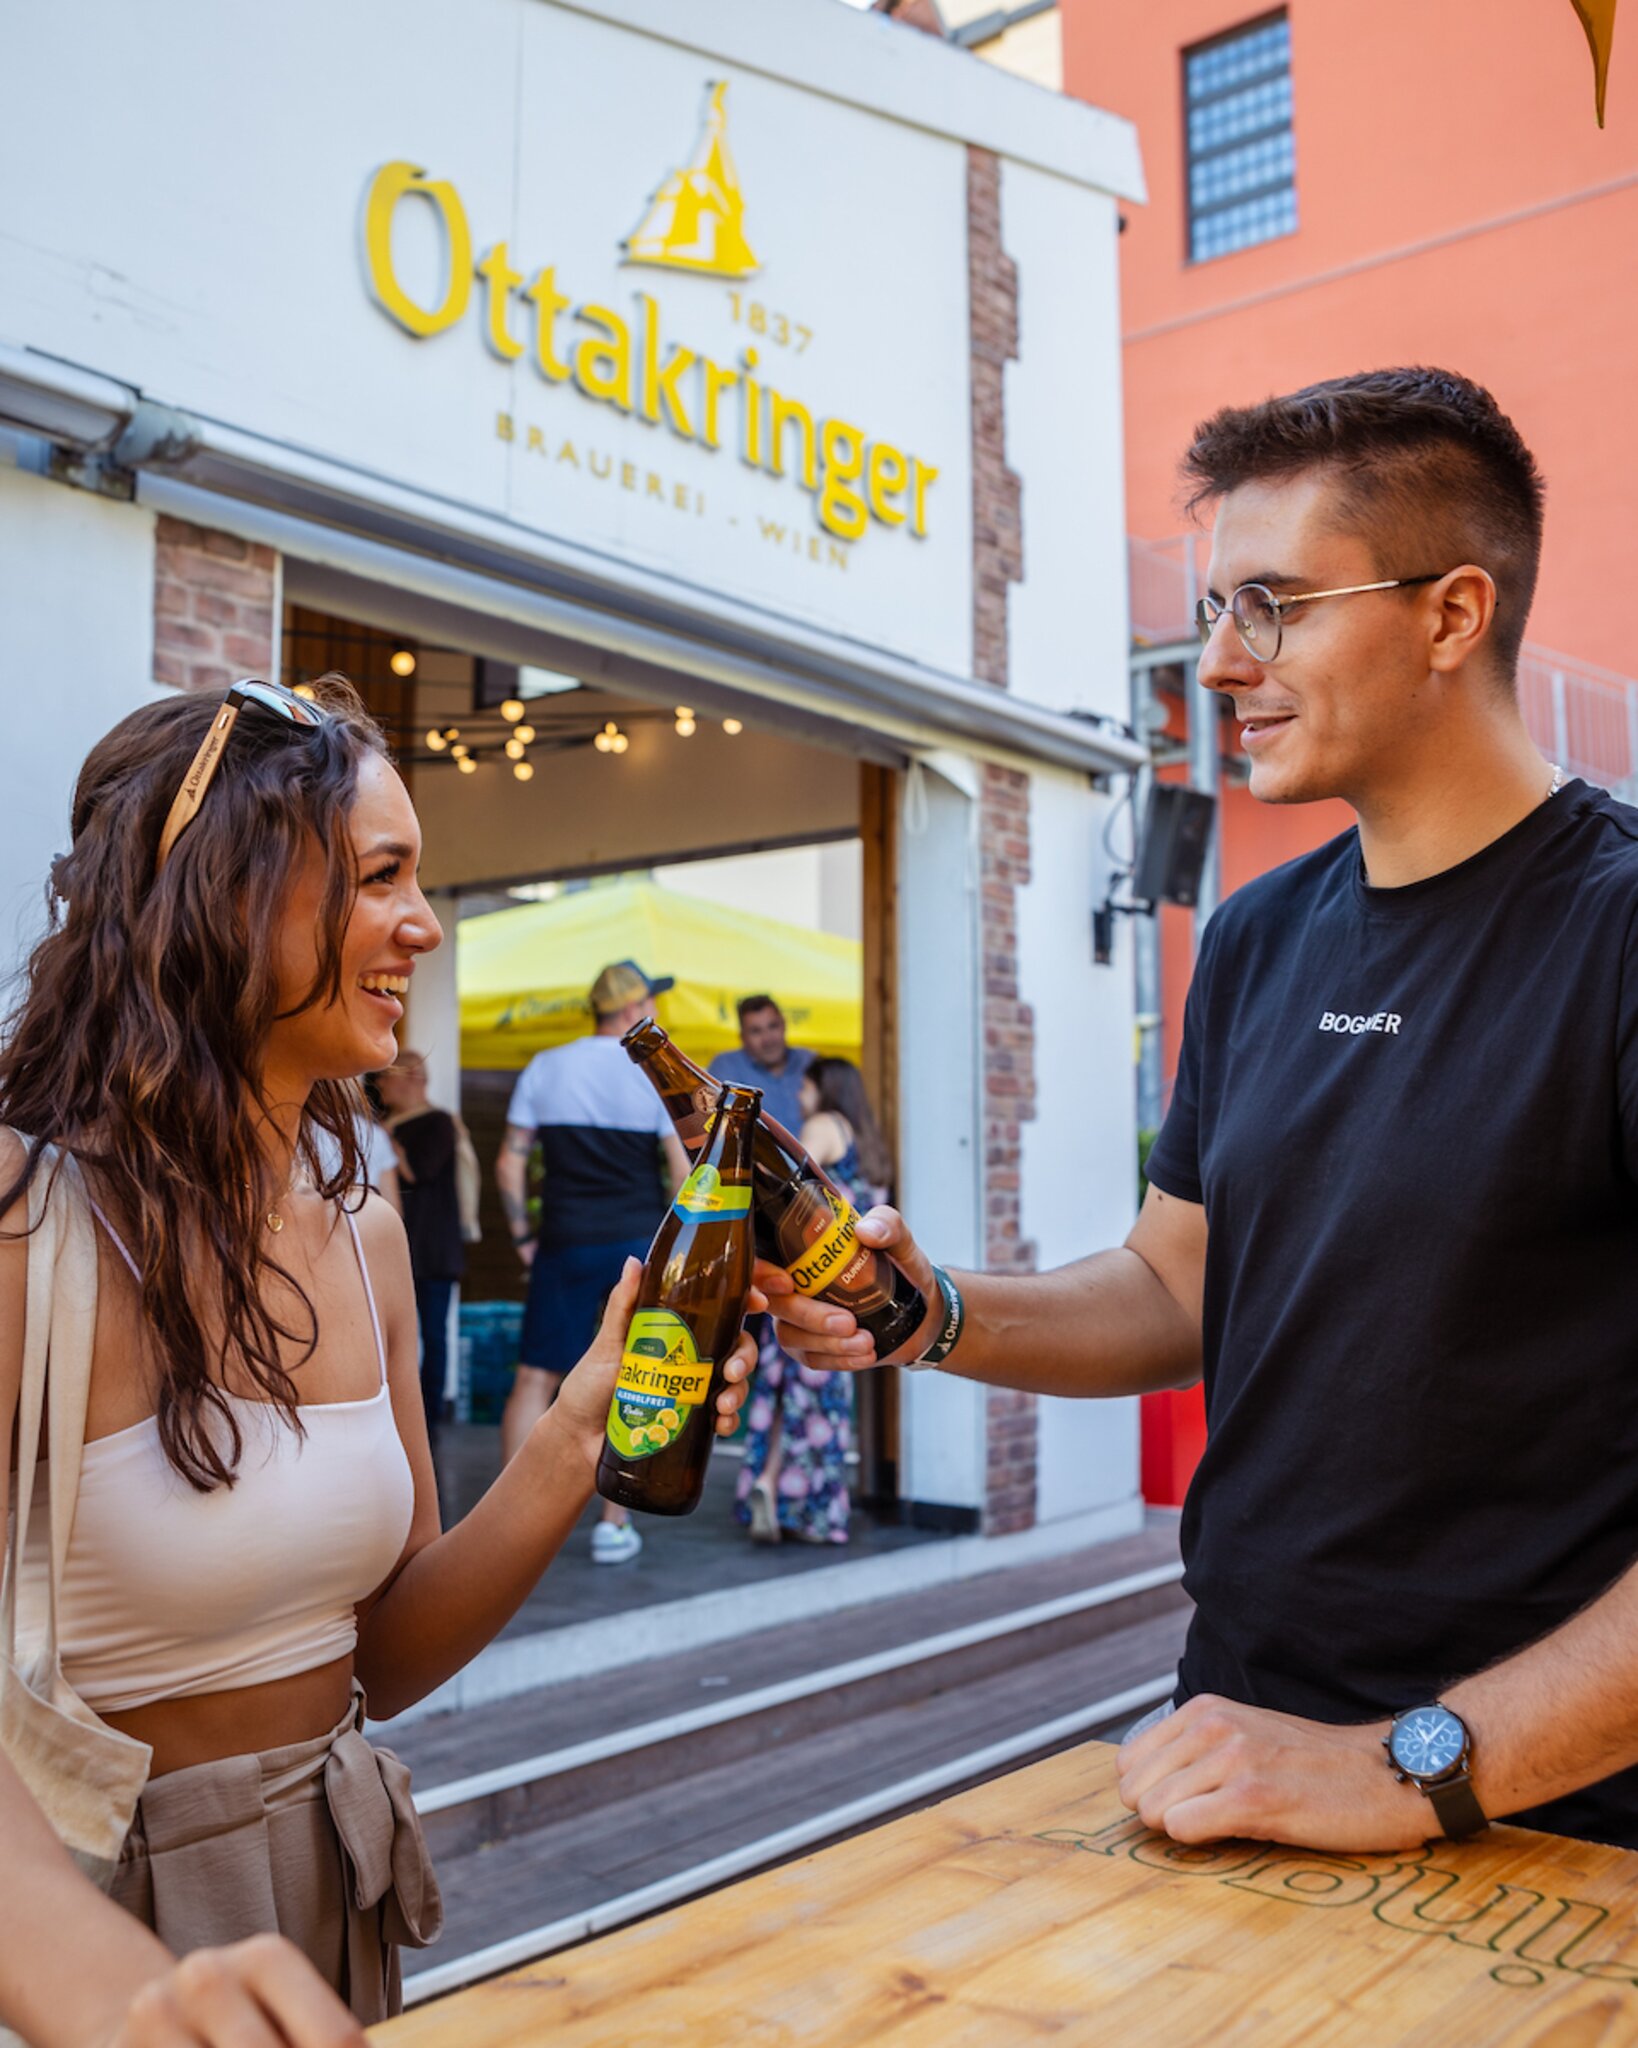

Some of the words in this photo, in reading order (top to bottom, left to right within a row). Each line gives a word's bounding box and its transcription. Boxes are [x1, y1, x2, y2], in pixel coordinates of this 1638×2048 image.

[362, 160, 939, 541] Ottakringer
[728, 292, 813, 353] 1837
[496, 413, 704, 518] BRAUEREI
[756, 515, 848, 572] WIEN
